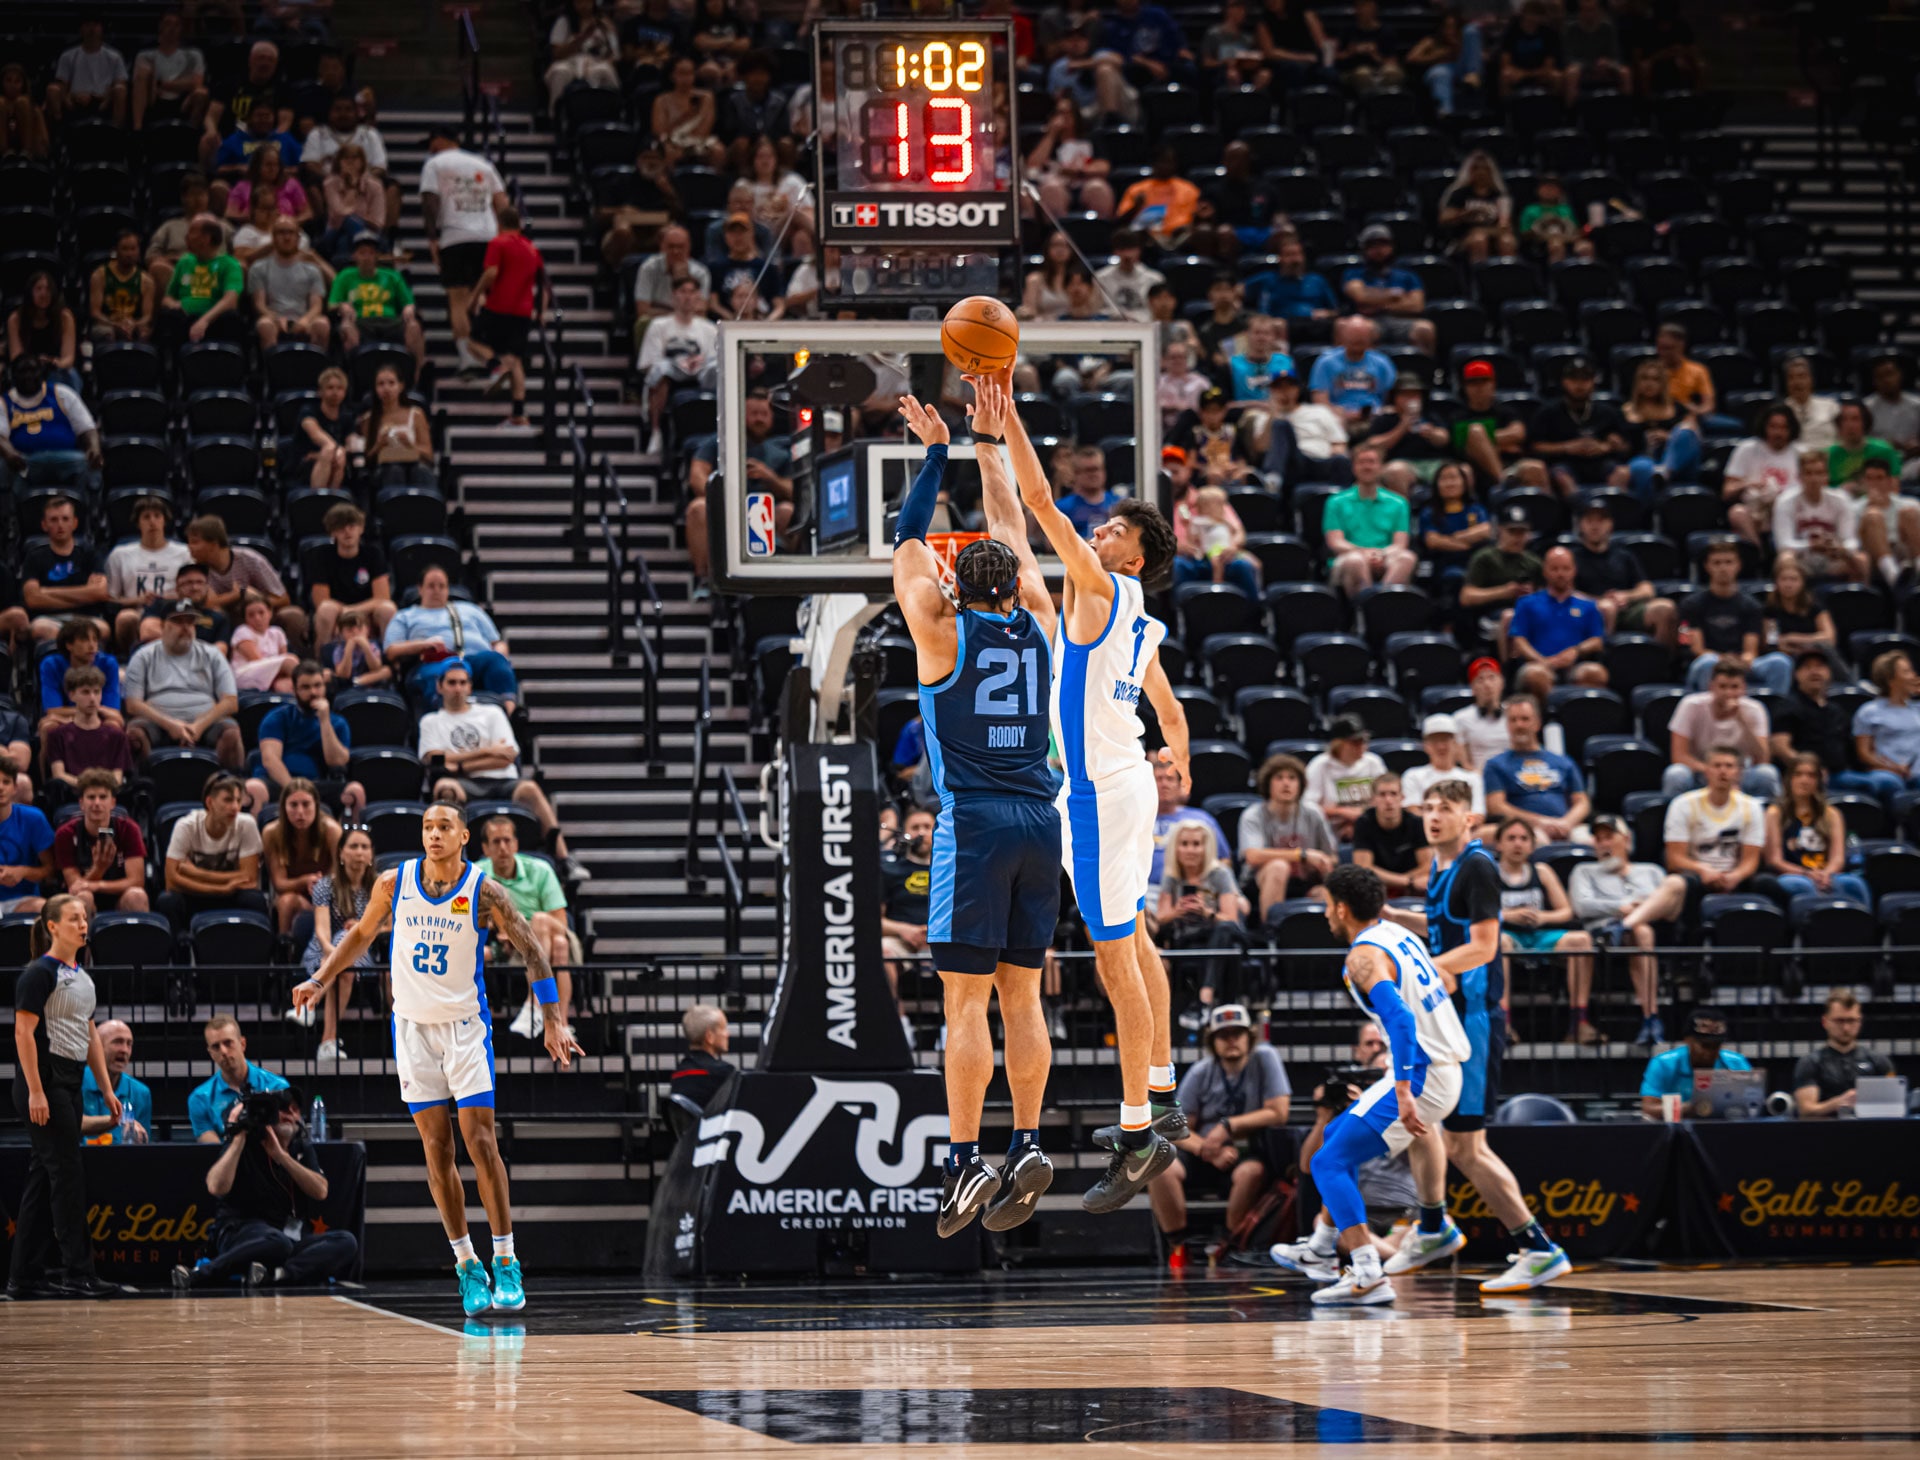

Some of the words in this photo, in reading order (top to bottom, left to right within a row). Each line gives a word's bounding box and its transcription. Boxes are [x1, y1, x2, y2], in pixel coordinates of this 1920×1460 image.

[896, 42, 985, 91] 1:02
[897, 98, 973, 183] 13
[880, 203, 1006, 227] TISSOT
[1128, 616, 1150, 677] 7
[975, 648, 1038, 715] 21
[988, 726, 1027, 748] RODDY
[819, 757, 852, 866] FIRST
[406, 915, 463, 933] OKLAHOMA
[421, 930, 444, 941] CITY
[413, 942, 449, 976] 23
[825, 872, 857, 1050] AMERICA
[727, 1188, 866, 1214] AMERICA
[1448, 1182, 1541, 1218] Lae
[1540, 1178, 1618, 1226] City
[1738, 1178, 1823, 1227] Salt
[1824, 1180, 1920, 1217] Lake
[780, 1217, 842, 1229] CREDIT
[853, 1217, 906, 1228] UNION
[1769, 1224, 1864, 1238] SUMMER
